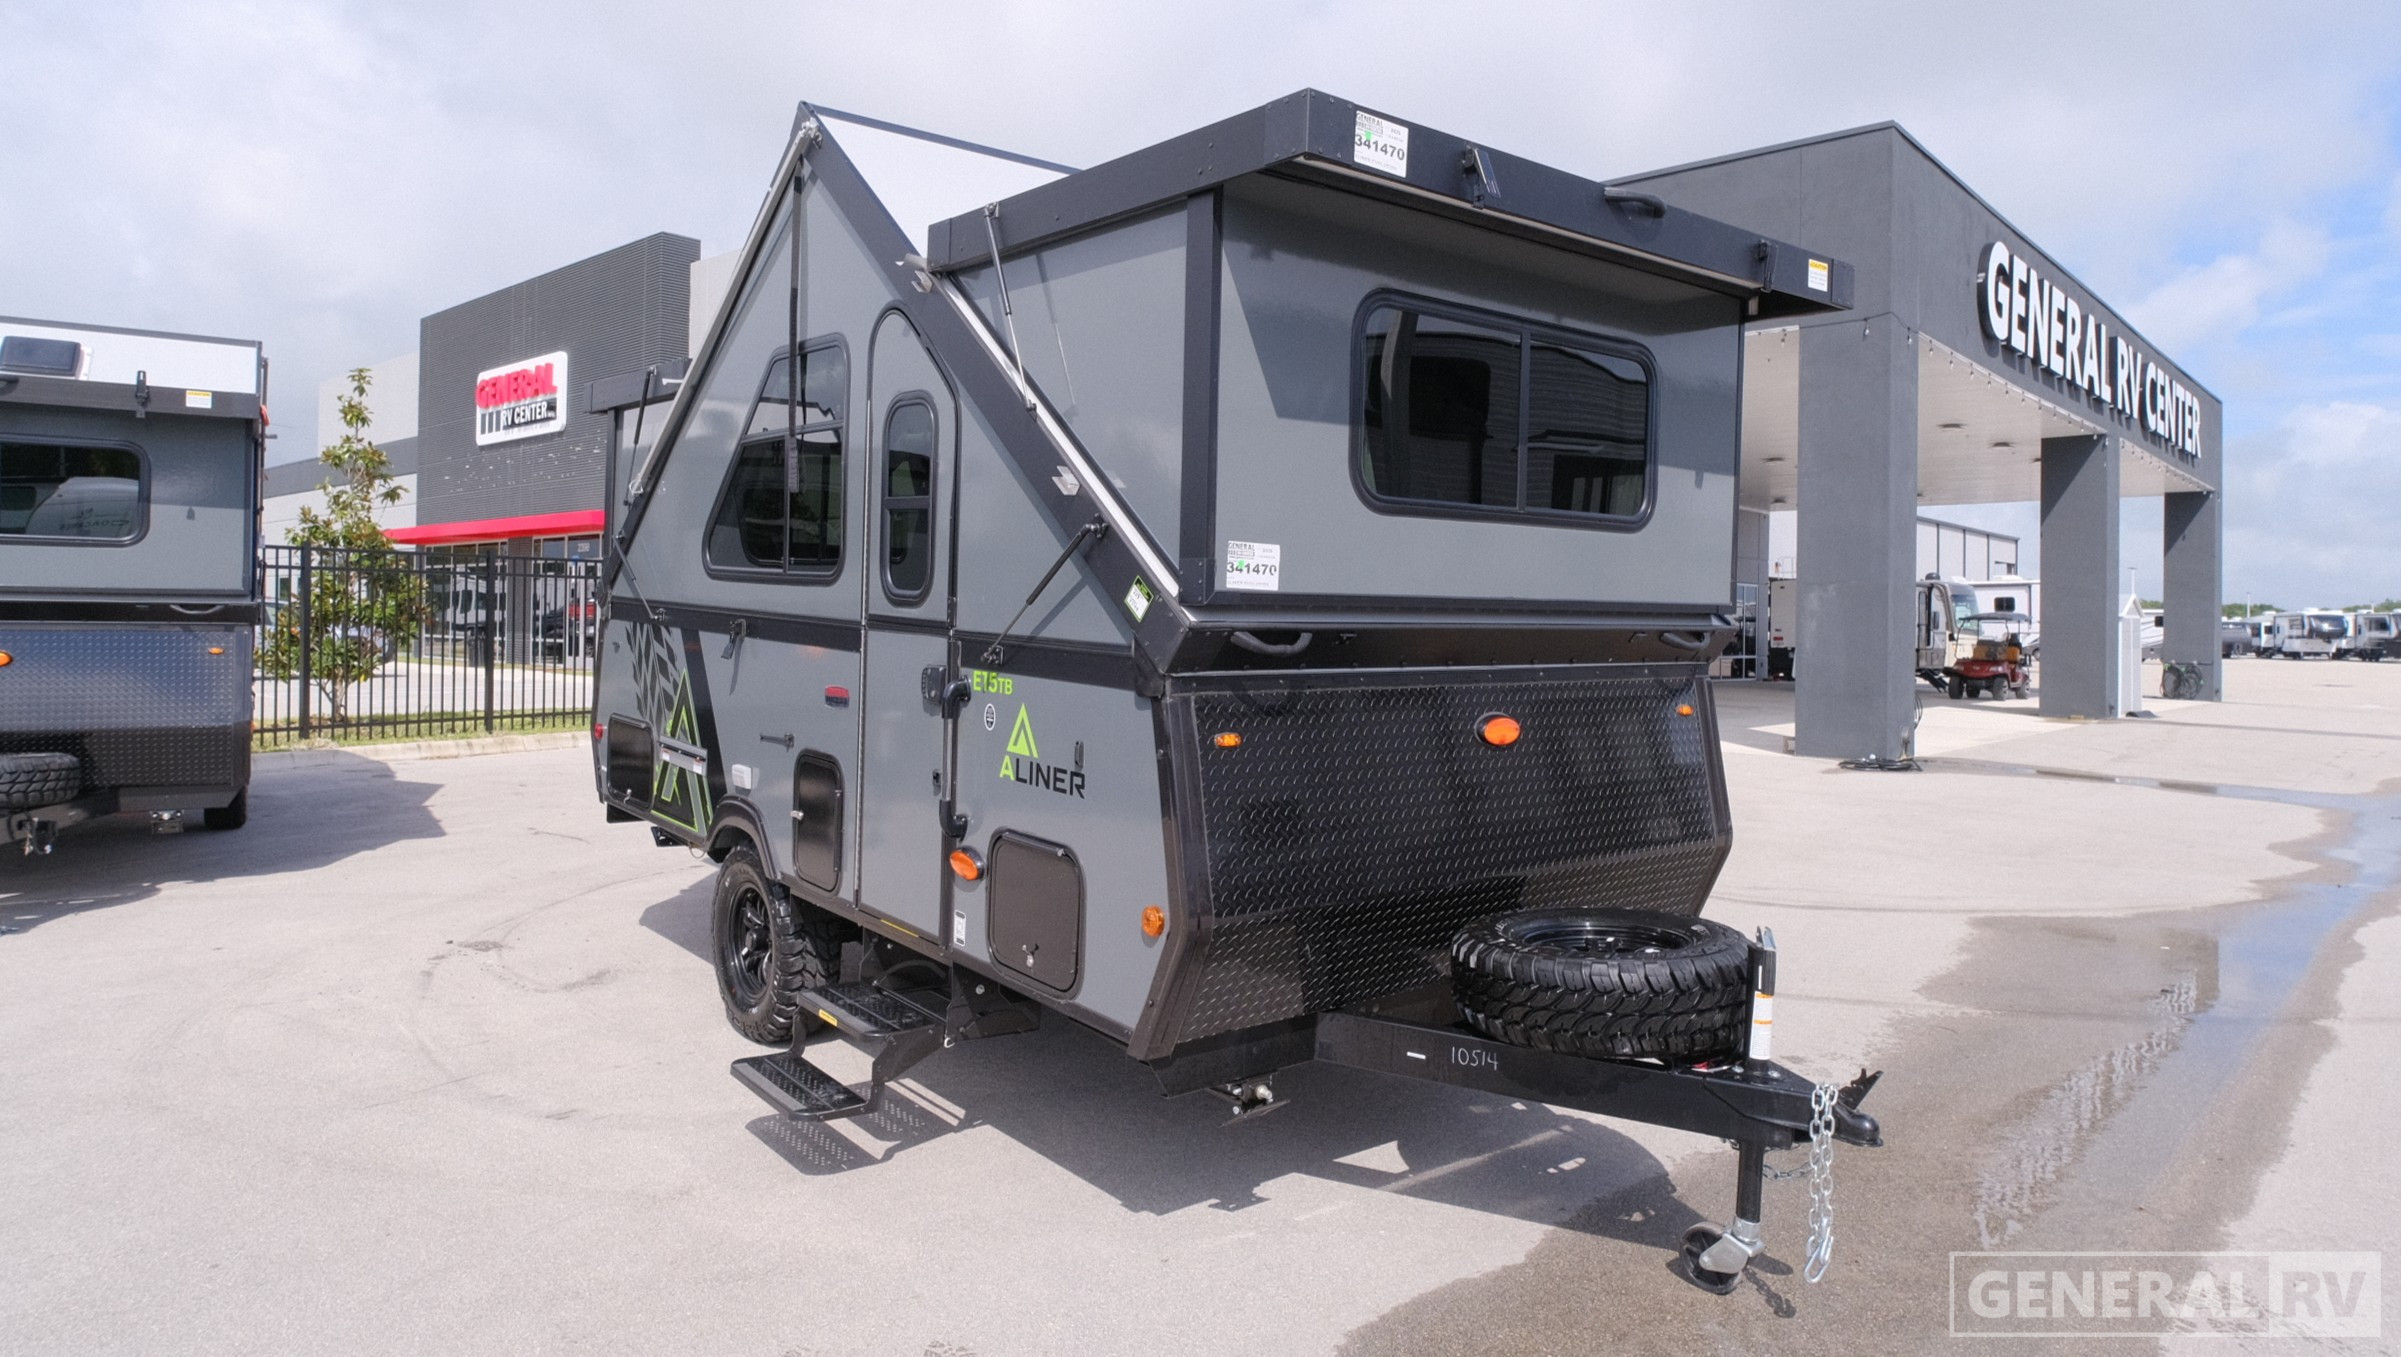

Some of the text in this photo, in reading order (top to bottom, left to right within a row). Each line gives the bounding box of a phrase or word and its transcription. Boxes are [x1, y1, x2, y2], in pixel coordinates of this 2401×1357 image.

[1355, 134, 1405, 161] 341470
[1986, 240, 2202, 459] GENERAL RV CENTER
[476, 362, 558, 411] GENERAL
[501, 400, 548, 427] RV CENTER
[1227, 562, 1277, 576] 341470
[973, 670, 1013, 695] E15TB
[999, 754, 1086, 800] ALINER
[1451, 1045, 1498, 1071] 10514
